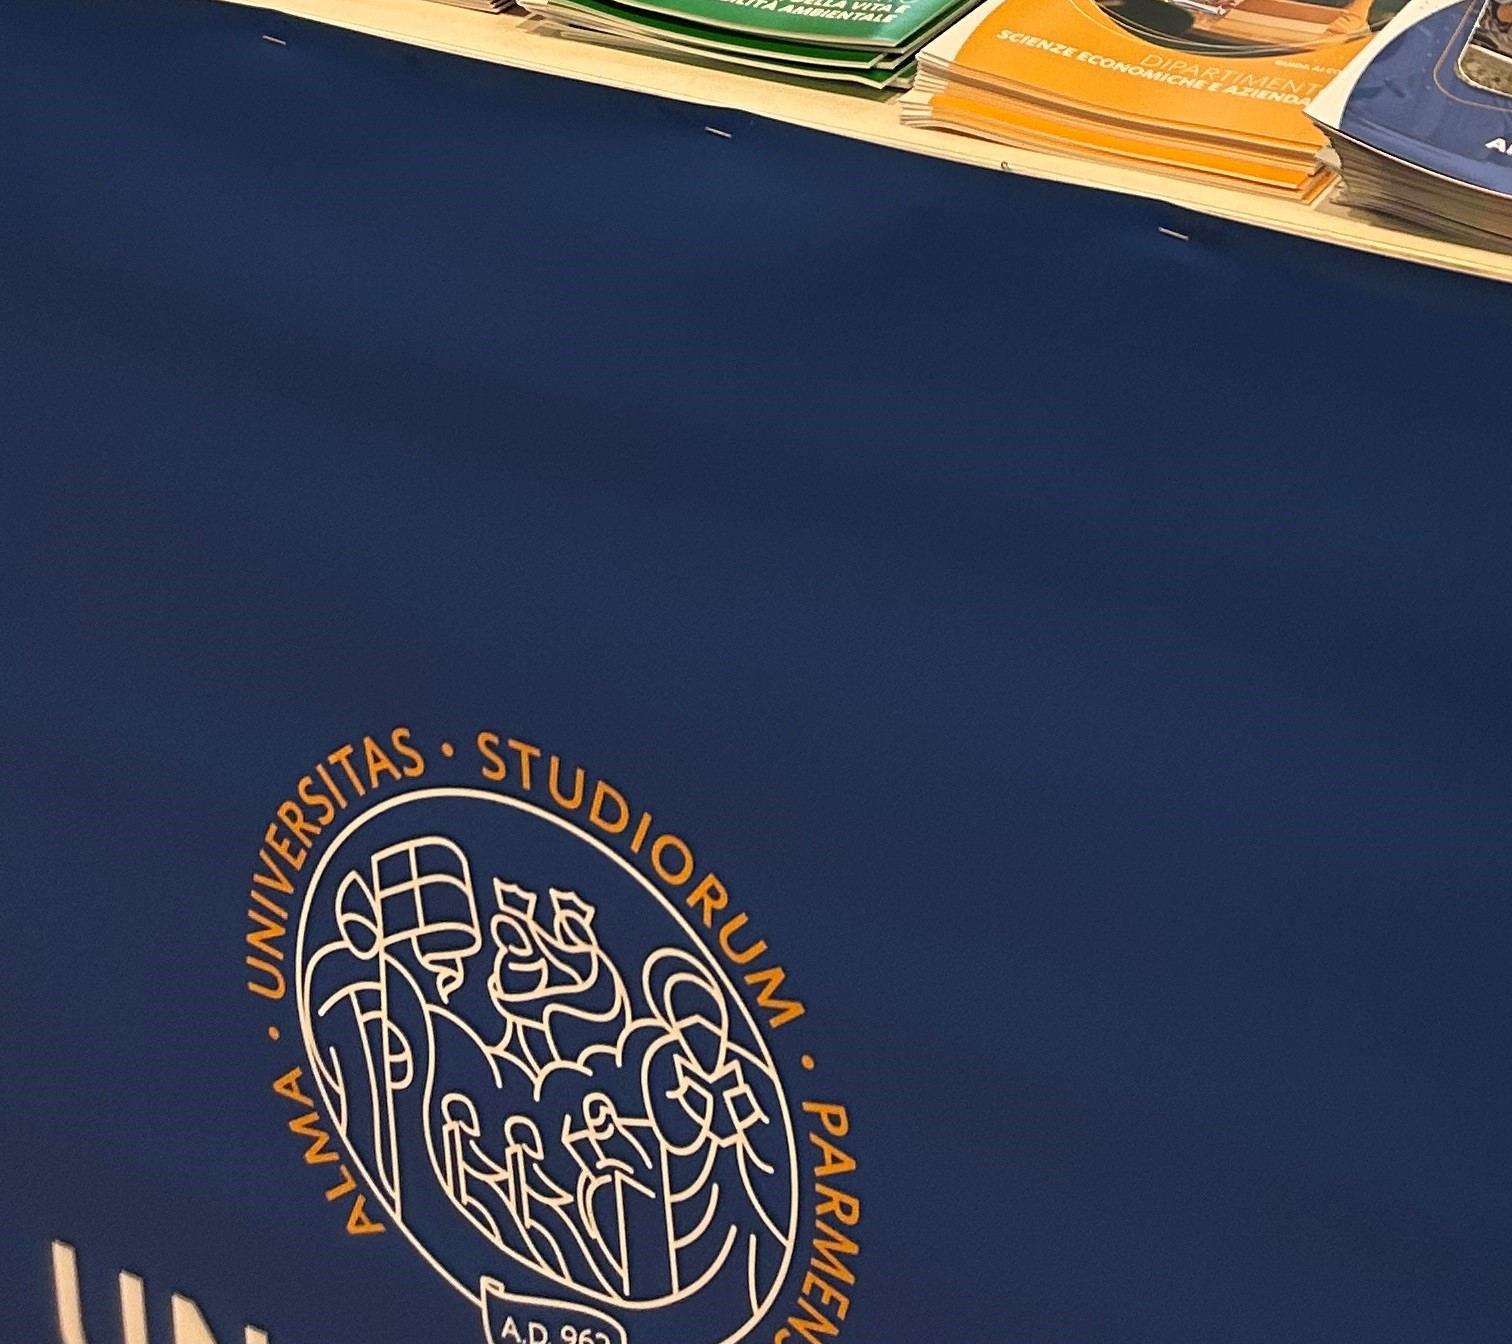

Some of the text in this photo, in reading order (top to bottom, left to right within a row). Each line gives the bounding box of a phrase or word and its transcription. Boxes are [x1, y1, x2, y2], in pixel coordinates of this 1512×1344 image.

[777, 4, 898, 24] AMBIENTALE
[851, 0, 897, 12] VITA
[897, 4, 912, 14] E
[995, 29, 1313, 107] SCIENZE ECONOMICHE E AZIENDA
[1139, 53, 1325, 98] DIPARTIMENT
[245, 726, 428, 1002] UNIVERSITAS
[476, 730, 806, 1032] STUDIORUM
[271, 1064, 386, 1238] ALMA
